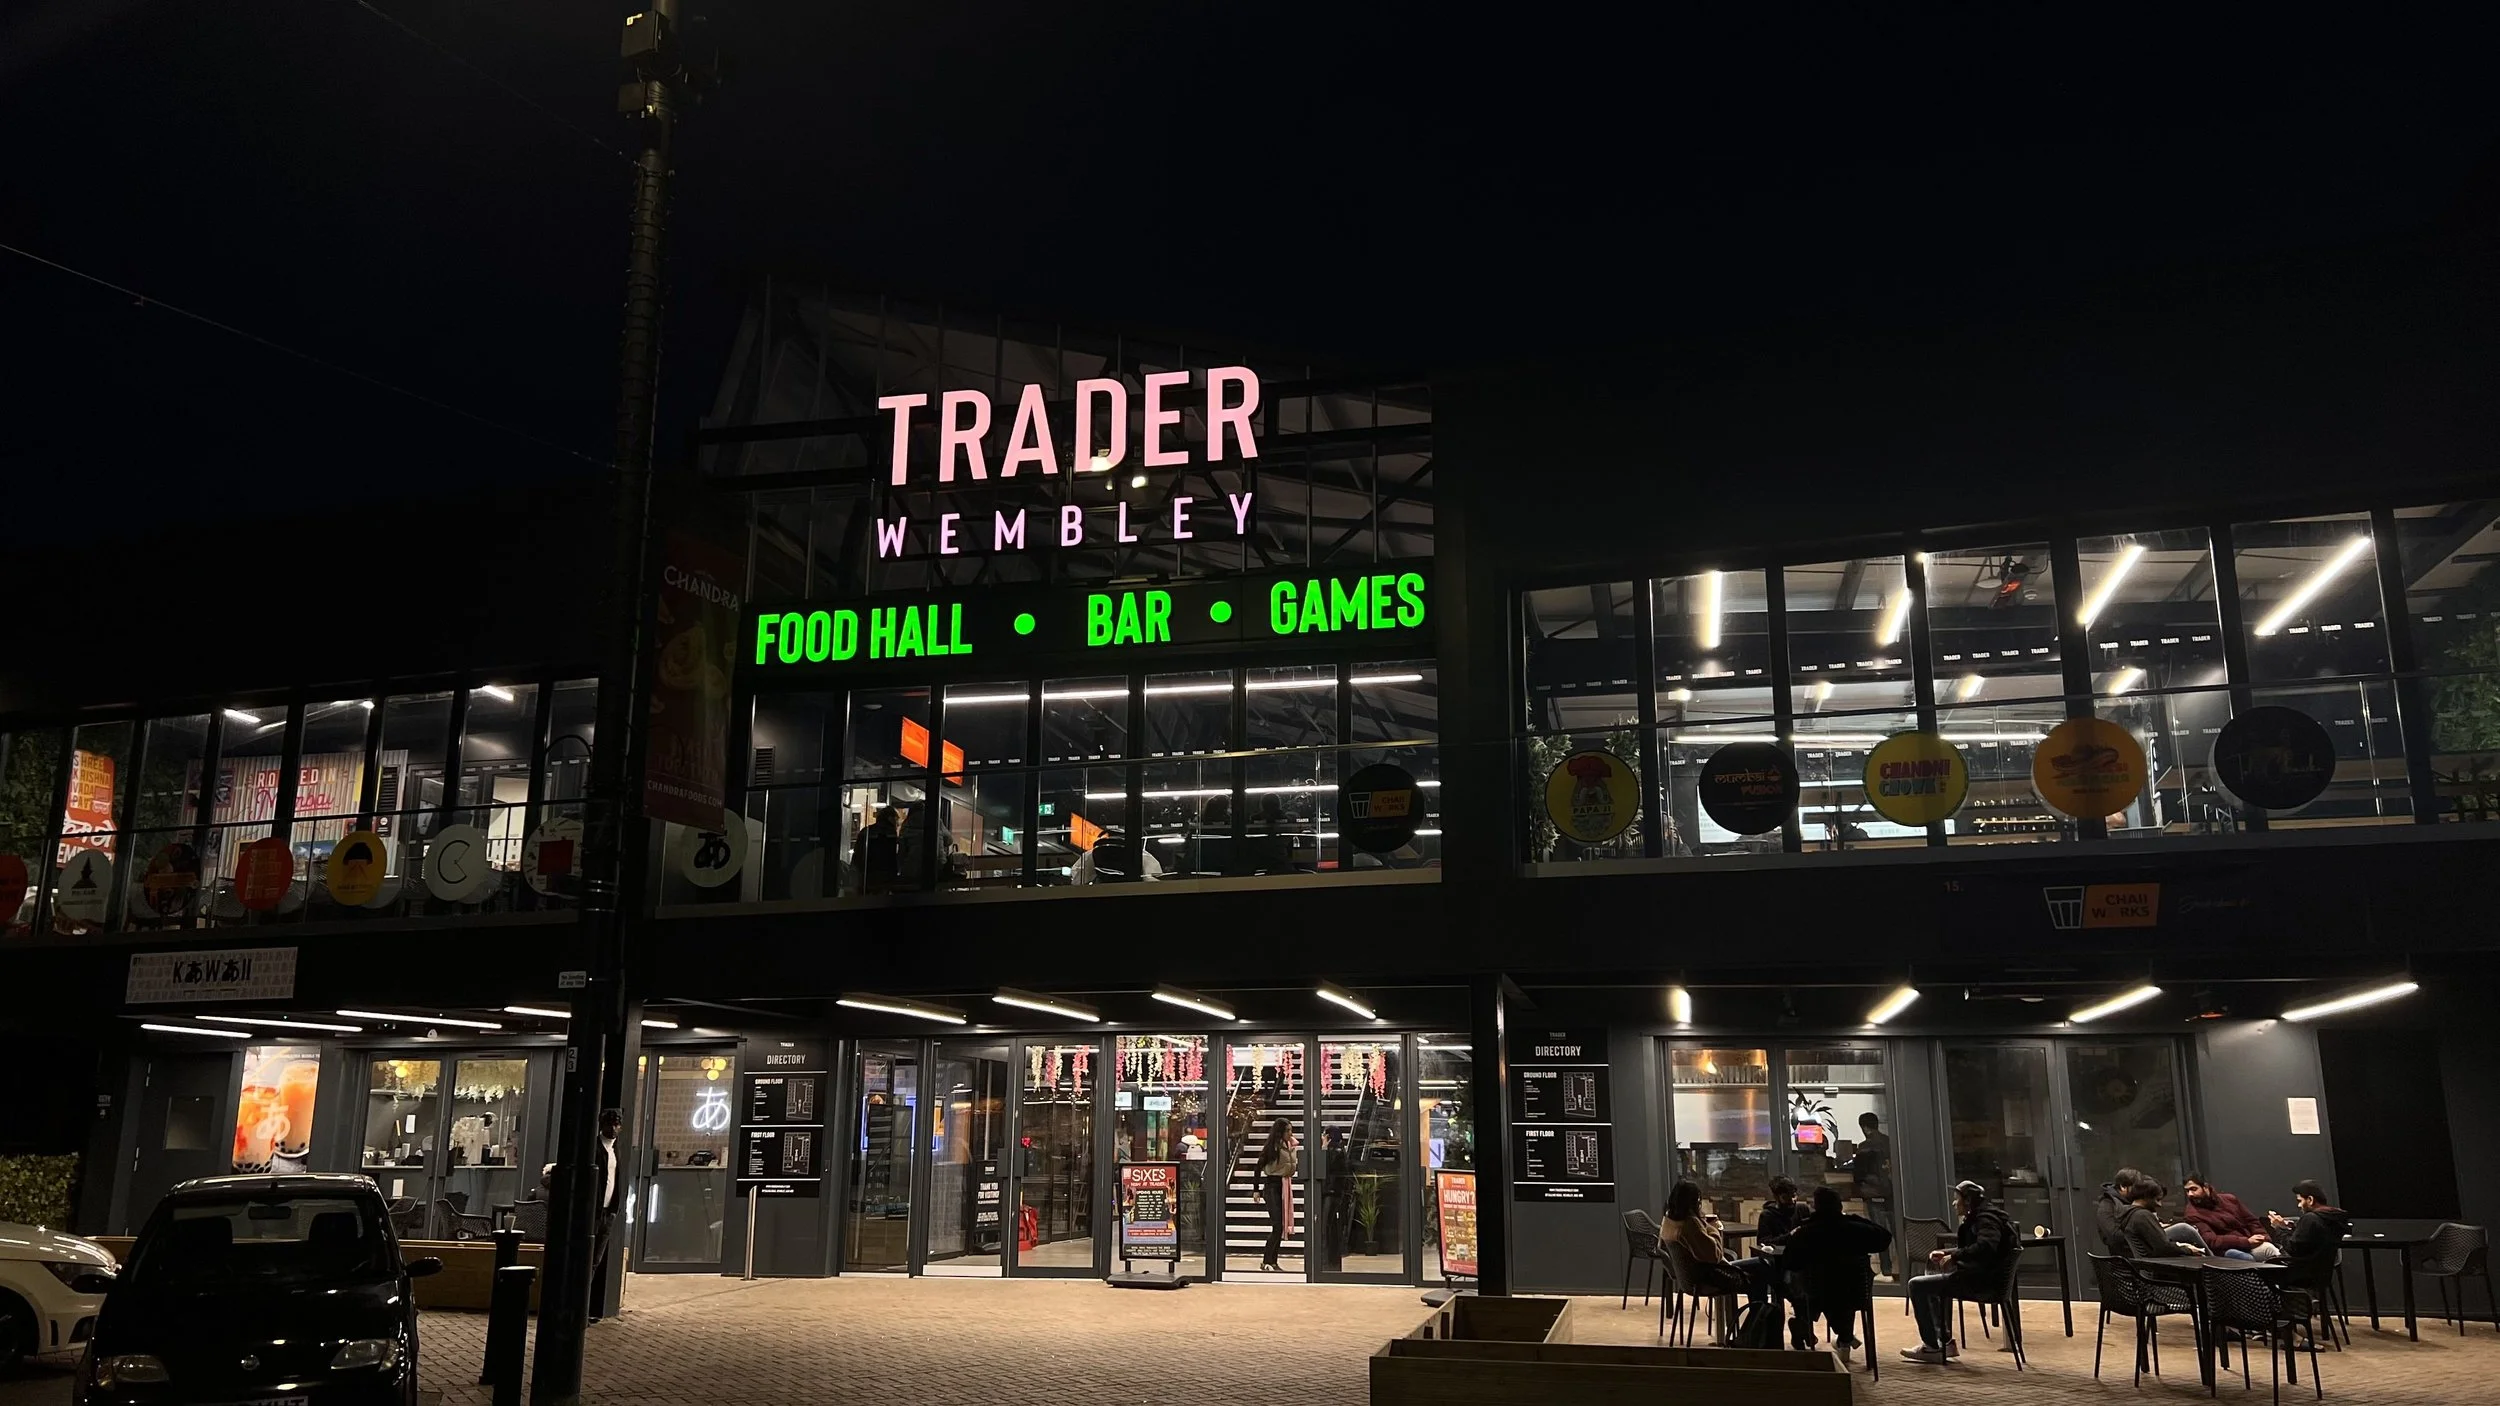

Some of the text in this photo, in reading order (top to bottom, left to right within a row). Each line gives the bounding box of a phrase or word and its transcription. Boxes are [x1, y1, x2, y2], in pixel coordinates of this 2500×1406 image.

[878, 366, 1260, 485] TRADER
[876, 492, 1253, 558] WEMBLEY
[664, 565, 738, 612] CHANDRA
[756, 573, 1424, 664] FOOD HALL BAR GAMES
[73, 751, 104, 770] SHREE
[1880, 759, 1951, 779] CHANDNI
[73, 768, 110, 786] KRISHNA
[257, 768, 319, 788] ROED
[72, 781, 94, 796] VADA
[1879, 778, 1937, 797] CHOWK
[1574, 806, 1599, 814] PAPA
[2105, 893, 2148, 906] CHAII
[767, 1054, 806, 1065] DIRECTORY
[1535, 1046, 1581, 1056] DIRECTORY
[691, 1086, 731, 1131] あ
[256, 1101, 291, 1142] あ
[1132, 1168, 1166, 1182] SIXES
[1443, 1189, 1475, 1204] HUNGRY?
